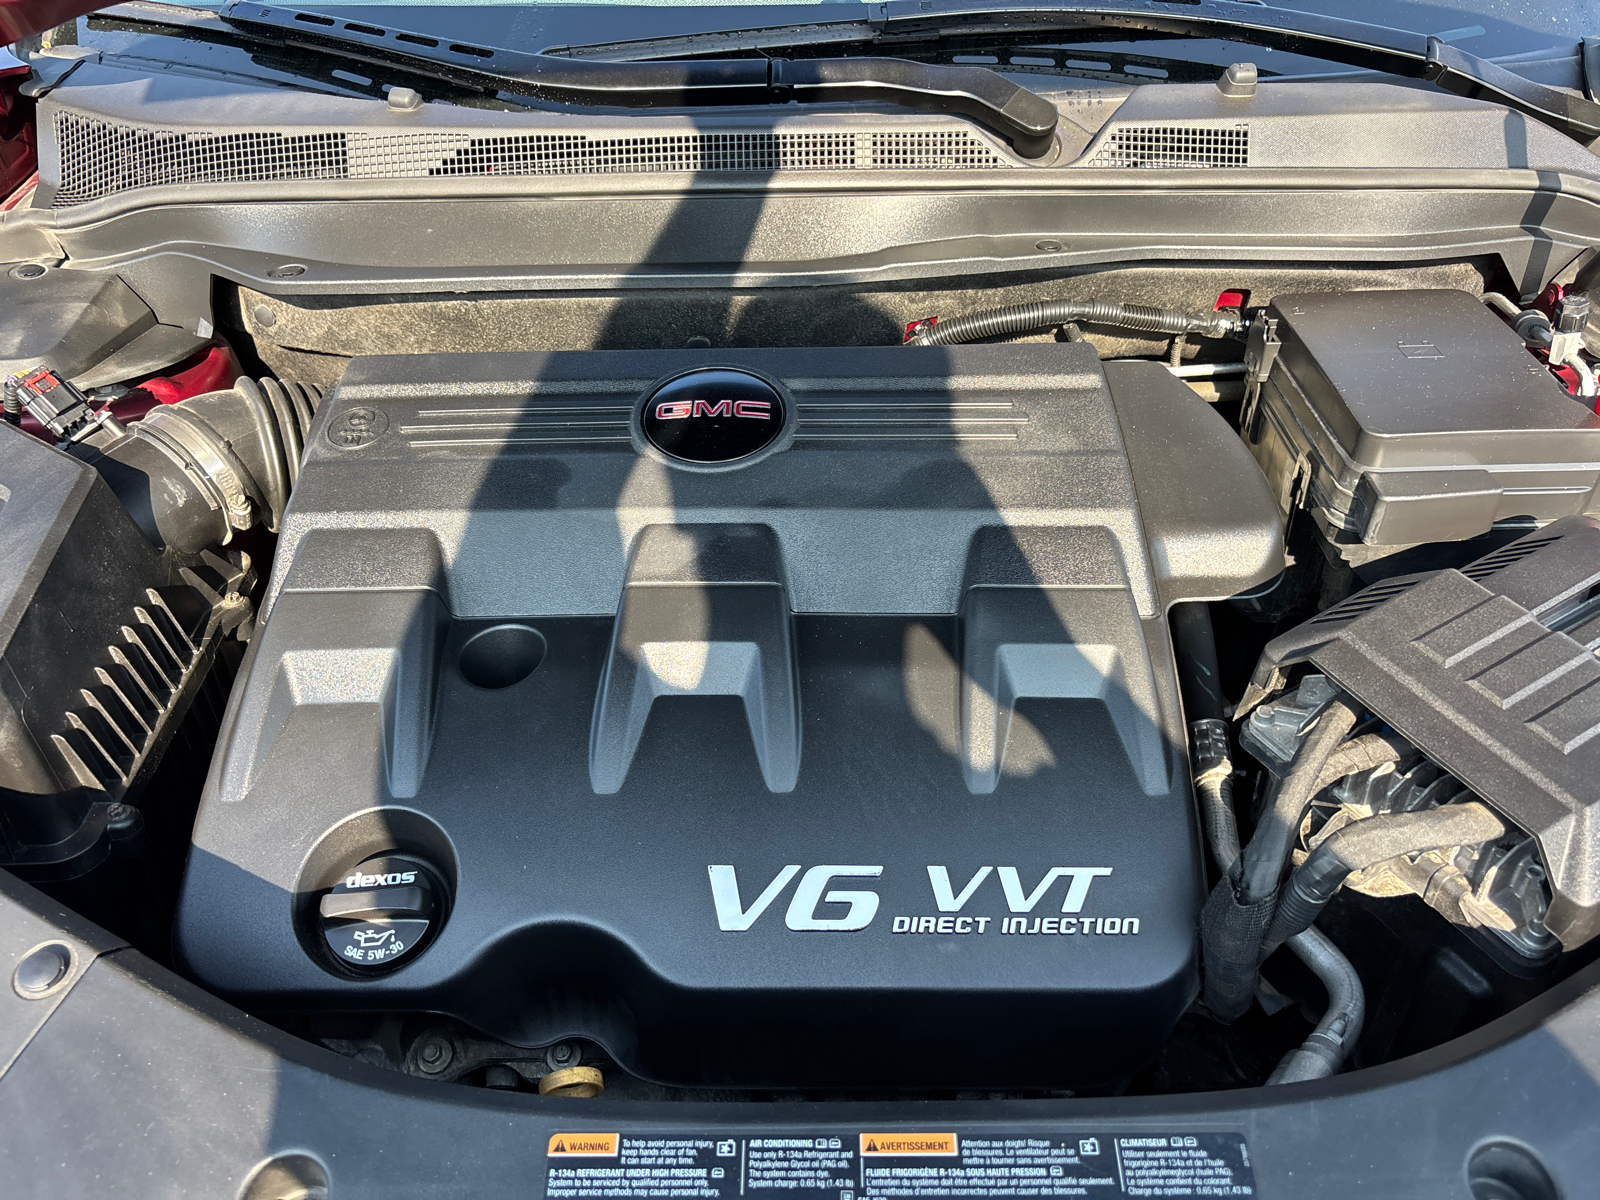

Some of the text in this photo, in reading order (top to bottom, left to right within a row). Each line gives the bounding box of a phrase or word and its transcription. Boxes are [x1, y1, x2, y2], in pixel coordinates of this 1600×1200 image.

[655, 399, 772, 420] GMC
[346, 871, 417, 889] dexos
[708, 864, 1113, 933] V6 VVT
[892, 916, 1140, 935] DIRECT INJECTION
[344, 940, 404, 960] SAE 5W-30
[569, 1142, 610, 1152] WARNING
[622, 1139, 630, 1148] To
[632, 1139, 645, 1148] help
[647, 1139, 663, 1148] avoid
[665, 1139, 693, 1148] personal
[749, 1139, 813, 1148] AIR CONDITIONING
[880, 1141, 948, 1151] AVERTISSEMENT
[961, 1139, 990, 1148] Attention
[992, 1139, 1003, 1148] aux
[1028, 1139, 1050, 1148] Risque
[1120, 1138, 1167, 1147] CLIMATISEUR
[621, 1148, 698, 1157] keep hands clear of fan.
[749, 1150, 853, 1159] Use only R-134a Refrigerant and
[962, 1147, 1074, 1156] de blessures. Le ventilateur peut se
[1122, 1149, 1207, 1158] Utiliser seulement le fluide
[627, 1156, 639, 1166] can
[640, 1156, 655, 1166] start
[657, 1156, 663, 1166] at
[665, 1156, 676, 1166] any
[678, 1156, 695, 1166] time.
[749, 1159, 789, 1169] Polyalkylene
[791, 1159, 809, 1169] Glycol
[811, 1159, 819, 1169] oil
[821, 1159, 835, 1169] (PAG
[962, 1156, 984, 1165] mettre
[992, 1156, 1015, 1165] tourner
[1016, 1156, 1031, 1165] sans
[1033, 1156, 1081, 1165] avertissement.
[1160, 1159, 1184, 1167] R-134a
[1186, 1159, 1192, 1167] et
[1194, 1159, 1202, 1167] de
[549, 1168, 707, 1177] R-134a REFRIGERANT UNDER HIGH PRESSURE
[749, 1169, 830, 1178] The system contains dye.
[866, 1166, 890, 1177] FLUIDE
[939, 1166, 965, 1177] R-134a
[966, 1166, 985, 1177] SOUS
[987, 1166, 1010, 1177] HAUTE
[1011, 1166, 1046, 1177] PRESSION
[1125, 1168, 1134, 1177] au
[1196, 1168, 1213, 1177] (huile
[548, 1178, 709, 1187] System to be serviced by qualified personnel only.
[748, 1179, 773, 1188] System
[774, 1179, 798, 1188] charge:
[800, 1179, 815, 1188] 0.65
[816, 1179, 825, 1188] kg
[845, 1179, 854, 1188] lb)
[901, 1177, 910, 1186] du
[940, 1177, 953, 1186] doit
[996, 1177, 1008, 1186] par
[1010, 1177, 1018, 1186] un
[1019, 1177, 1051, 1186] personnel
[1078, 1177, 1115, 1186] seulement.
[1126, 1177, 1135, 1186] Le
[1165, 1177, 1190, 1186] contient
[1192, 1177, 1202, 1186] du
[1203, 1177, 1232, 1186] colorant.
[547, 1187, 577, 1197] Improper
[578, 1187, 602, 1197] service
[604, 1187, 633, 1197] methods
[634, 1187, 648, 1197] may
[649, 1187, 669, 1197] cause
[671, 1187, 699, 1197] personal
[866, 1186, 879, 1196] Des
[951, 1186, 987, 1196] incorrectes
[989, 1186, 1015, 1196] peuvent
[1017, 1186, 1039, 1196] causer
[1040, 1186, 1052, 1196] des
[1054, 1186, 1088, 1196] blessures.
[1127, 1186, 1151, 1196] Charge
[1153, 1186, 1162, 1196] du
[1213, 1186, 1222, 1196] kg
[1242, 1186, 1252, 1196] lb)
